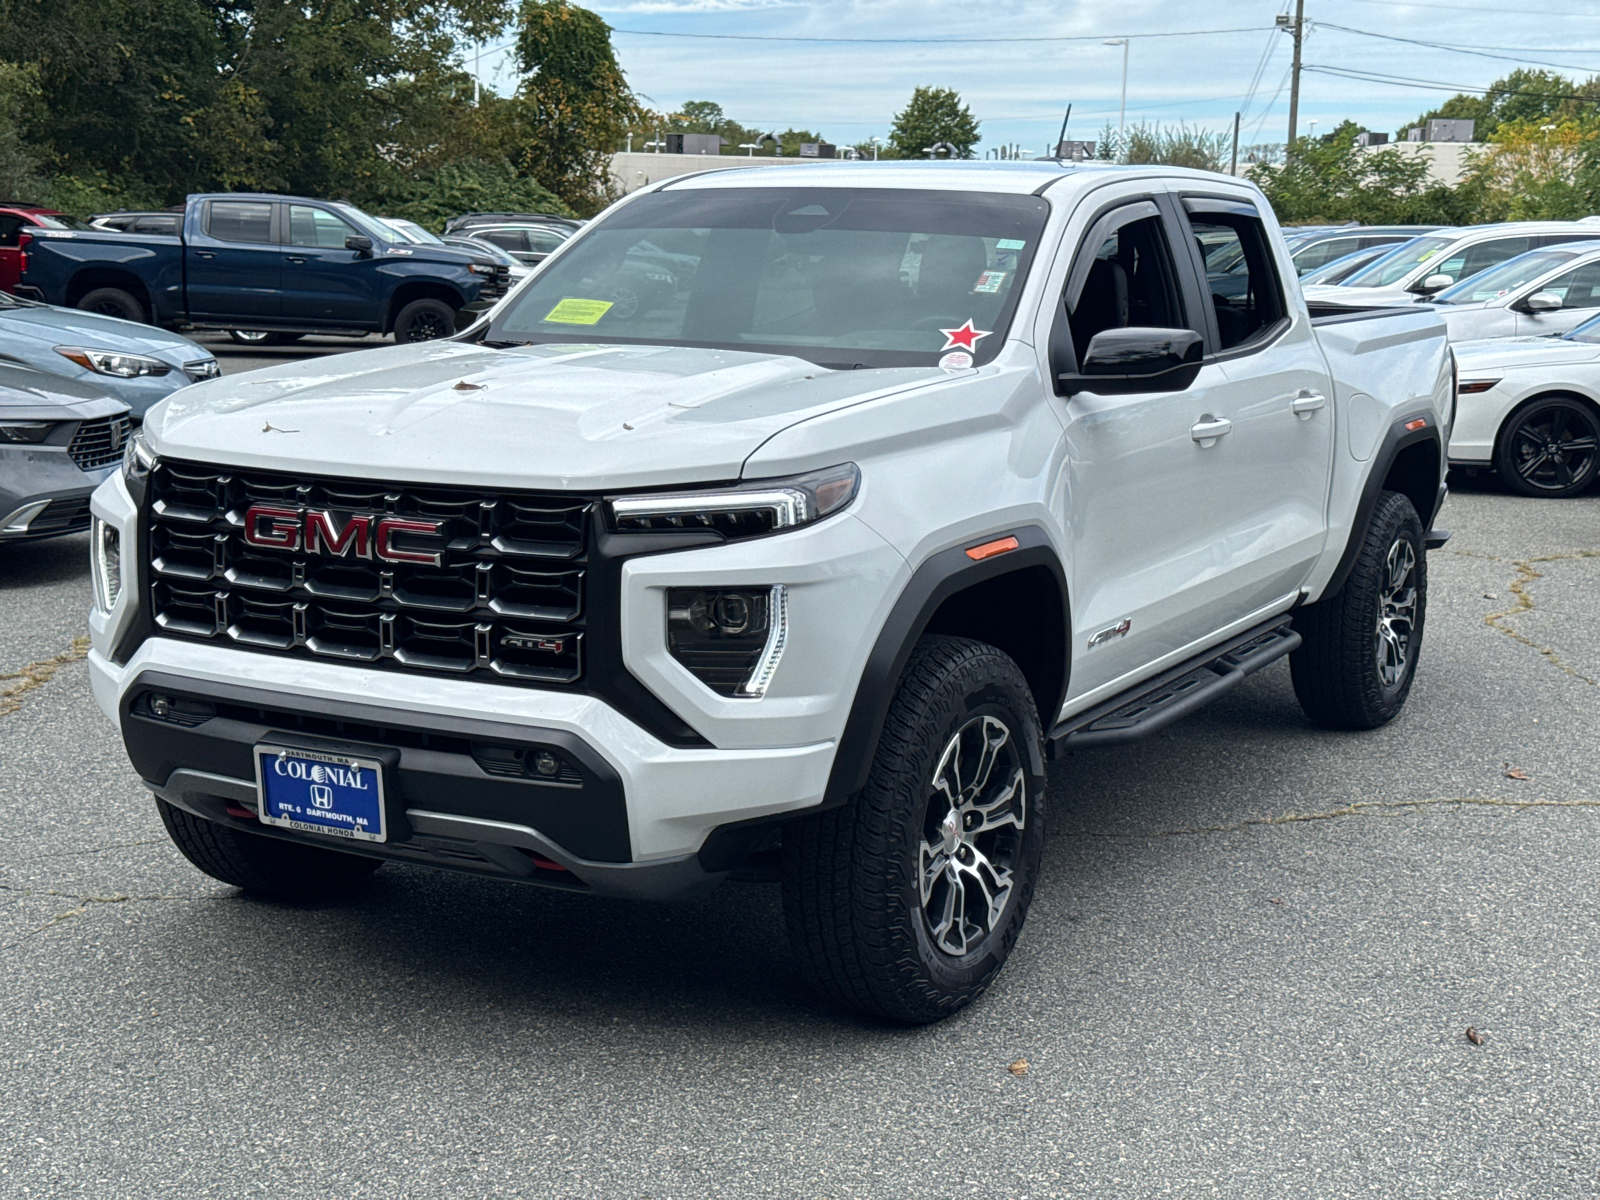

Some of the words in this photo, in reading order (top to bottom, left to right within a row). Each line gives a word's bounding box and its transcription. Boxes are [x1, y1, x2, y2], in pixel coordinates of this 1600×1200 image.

[245, 503, 443, 567] GMC
[1087, 616, 1131, 650] AT4
[500, 635, 563, 653] AT4
[337, 757, 350, 765] MA
[274, 759, 368, 790] COLONIAL
[296, 805, 301, 813] 6
[306, 808, 355, 825] DARTMOUTH,
[356, 817, 369, 826] MA
[289, 821, 326, 834] COLONIAL
[327, 826, 355, 838] HONDA
